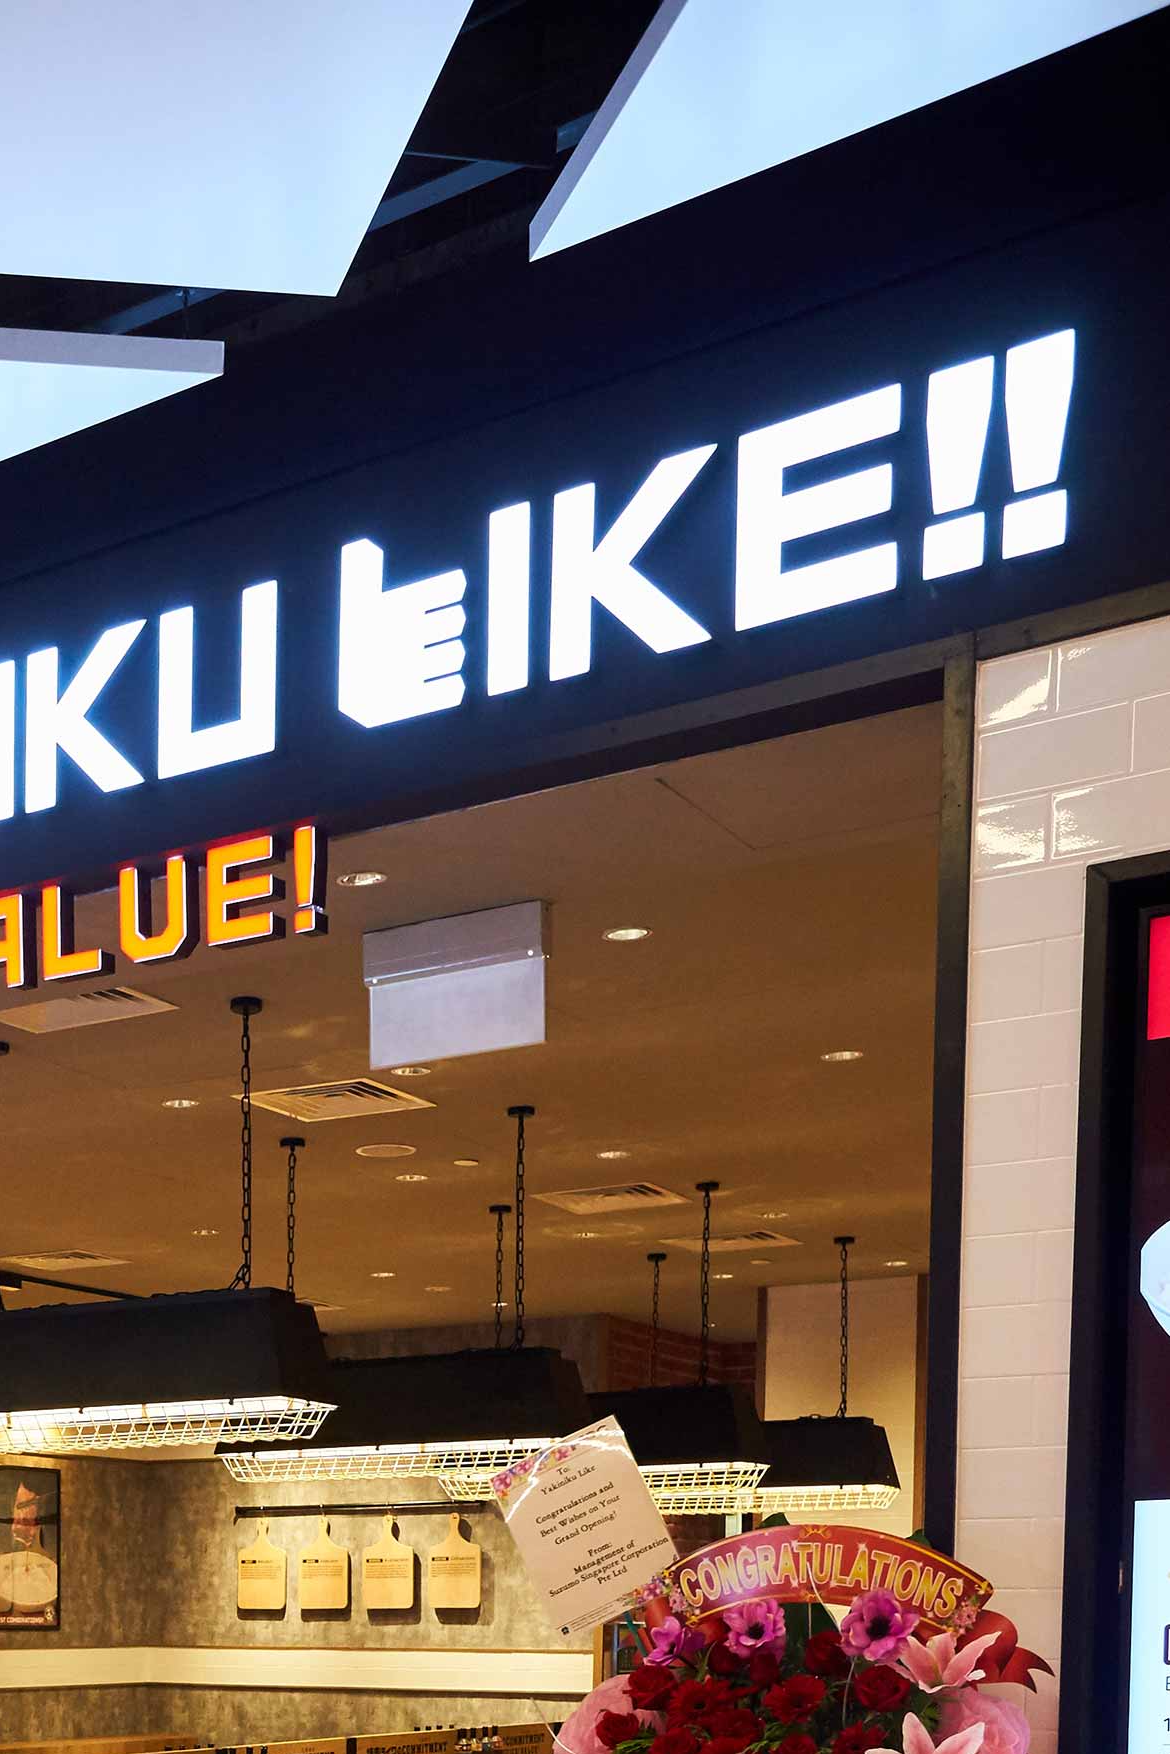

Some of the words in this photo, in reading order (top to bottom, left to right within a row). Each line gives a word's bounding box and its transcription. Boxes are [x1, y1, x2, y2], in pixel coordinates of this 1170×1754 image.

[541, 1475, 577, 1495] Yakiniku
[578, 1465, 597, 1477] Like
[536, 1492, 597, 1524] Congratulations
[599, 1481, 614, 1493] and
[540, 1526, 557, 1537] Best
[558, 1511, 587, 1527] Wishes
[588, 1505, 599, 1514] on
[599, 1495, 620, 1508] Your
[554, 1528, 580, 1545] Grand
[587, 1542, 613, 1557] From:
[573, 1547, 624, 1574] Management
[626, 1540, 635, 1550] of
[580, 1560, 619, 1582] Singapore
[620, 1537, 669, 1562] Corporation
[680, 1542, 964, 1619] CONGRATULATIONS
